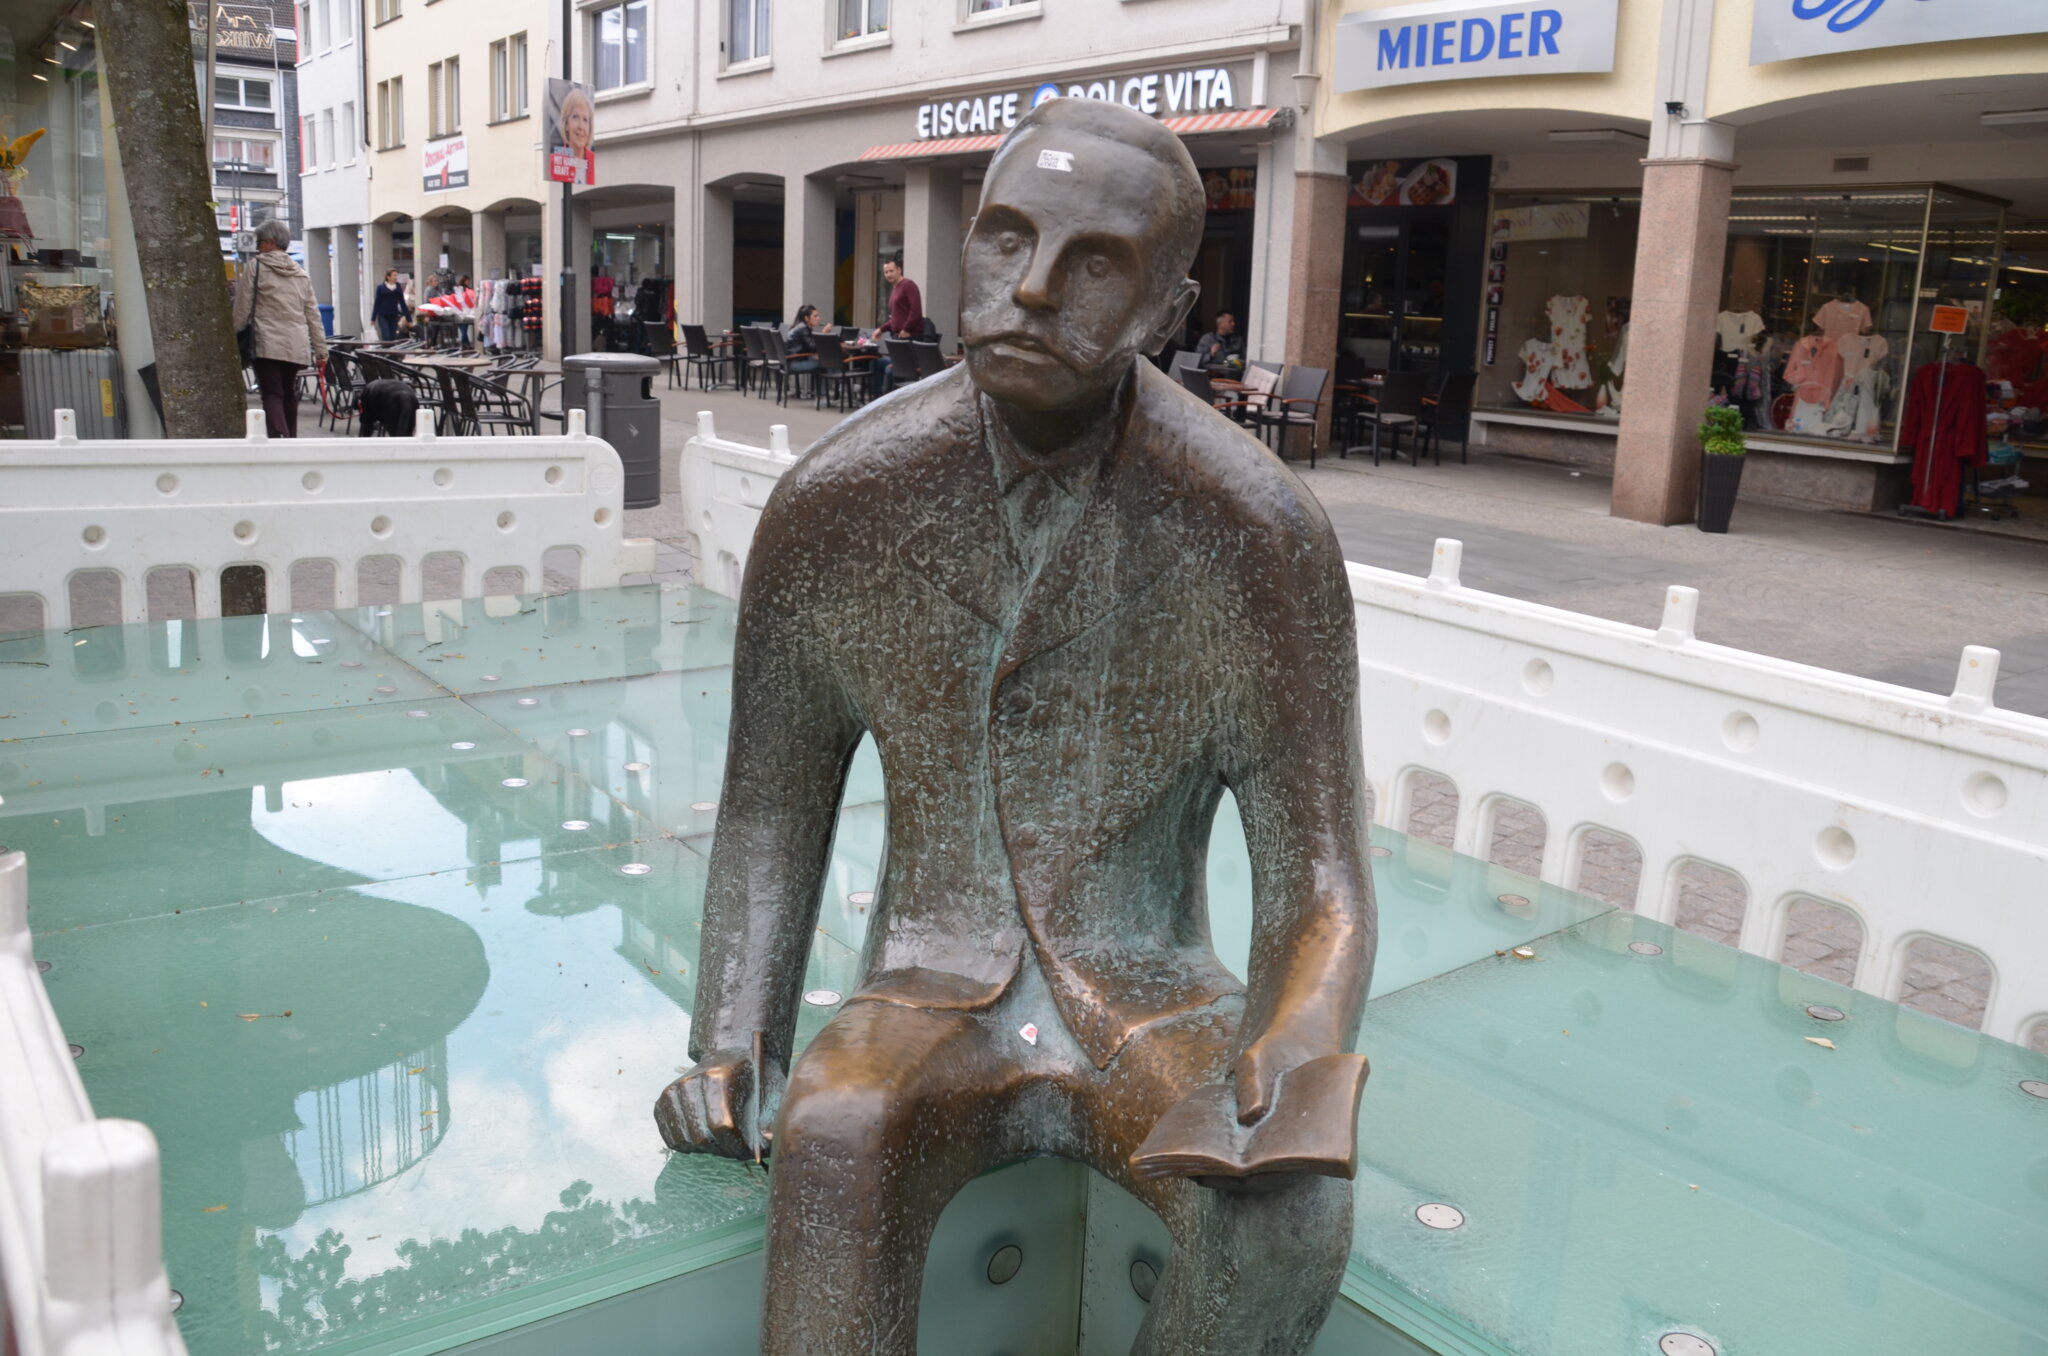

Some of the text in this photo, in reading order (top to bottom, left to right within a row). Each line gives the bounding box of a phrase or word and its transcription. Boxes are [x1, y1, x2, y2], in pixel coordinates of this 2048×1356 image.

[1377, 9, 1563, 71] MIEDER
[918, 93, 1018, 137] EISCAFE
[1165, 69, 1234, 112] VITA
